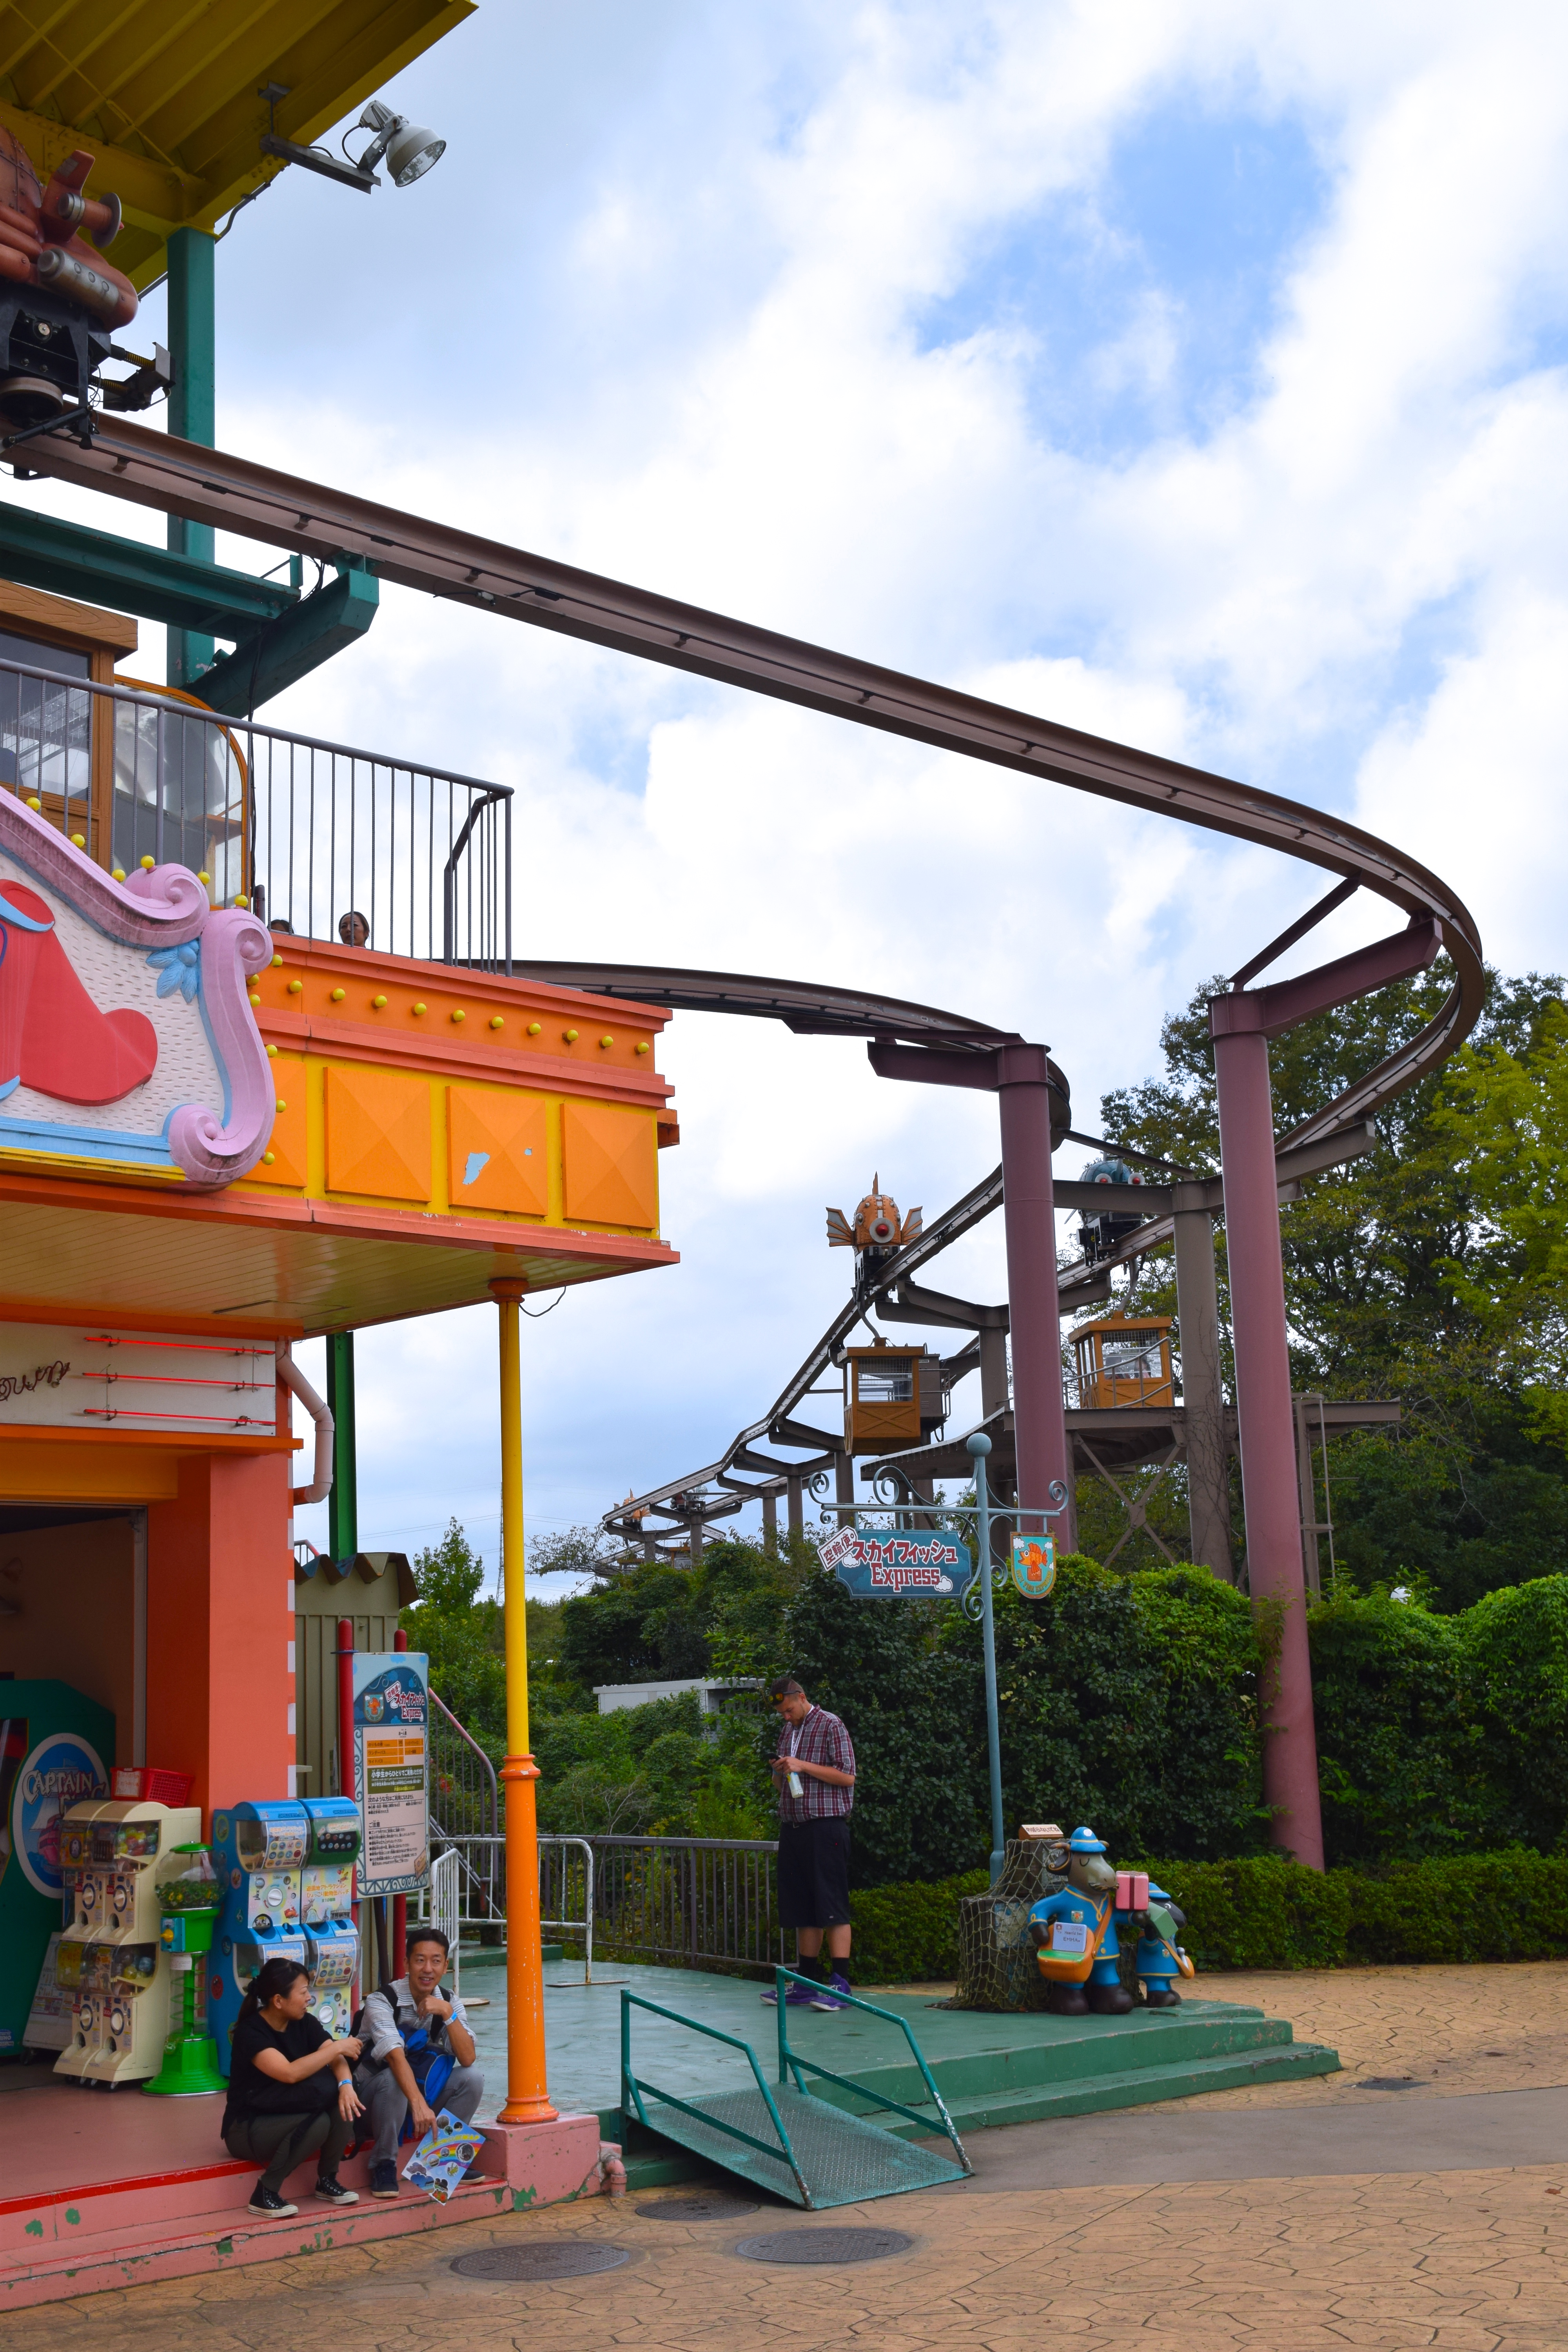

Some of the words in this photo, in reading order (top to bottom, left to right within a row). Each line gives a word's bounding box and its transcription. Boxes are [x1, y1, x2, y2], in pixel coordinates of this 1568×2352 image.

[823, 1533, 853, 1566] 空輸便
[853, 1539, 958, 1563] スカイフィッシュ
[871, 1562, 940, 1591] Express
[395, 1692, 425, 1705] スカイフィッシュ
[402, 1705, 421, 1721] Express
[22, 1769, 94, 1806] CAPTAIN
